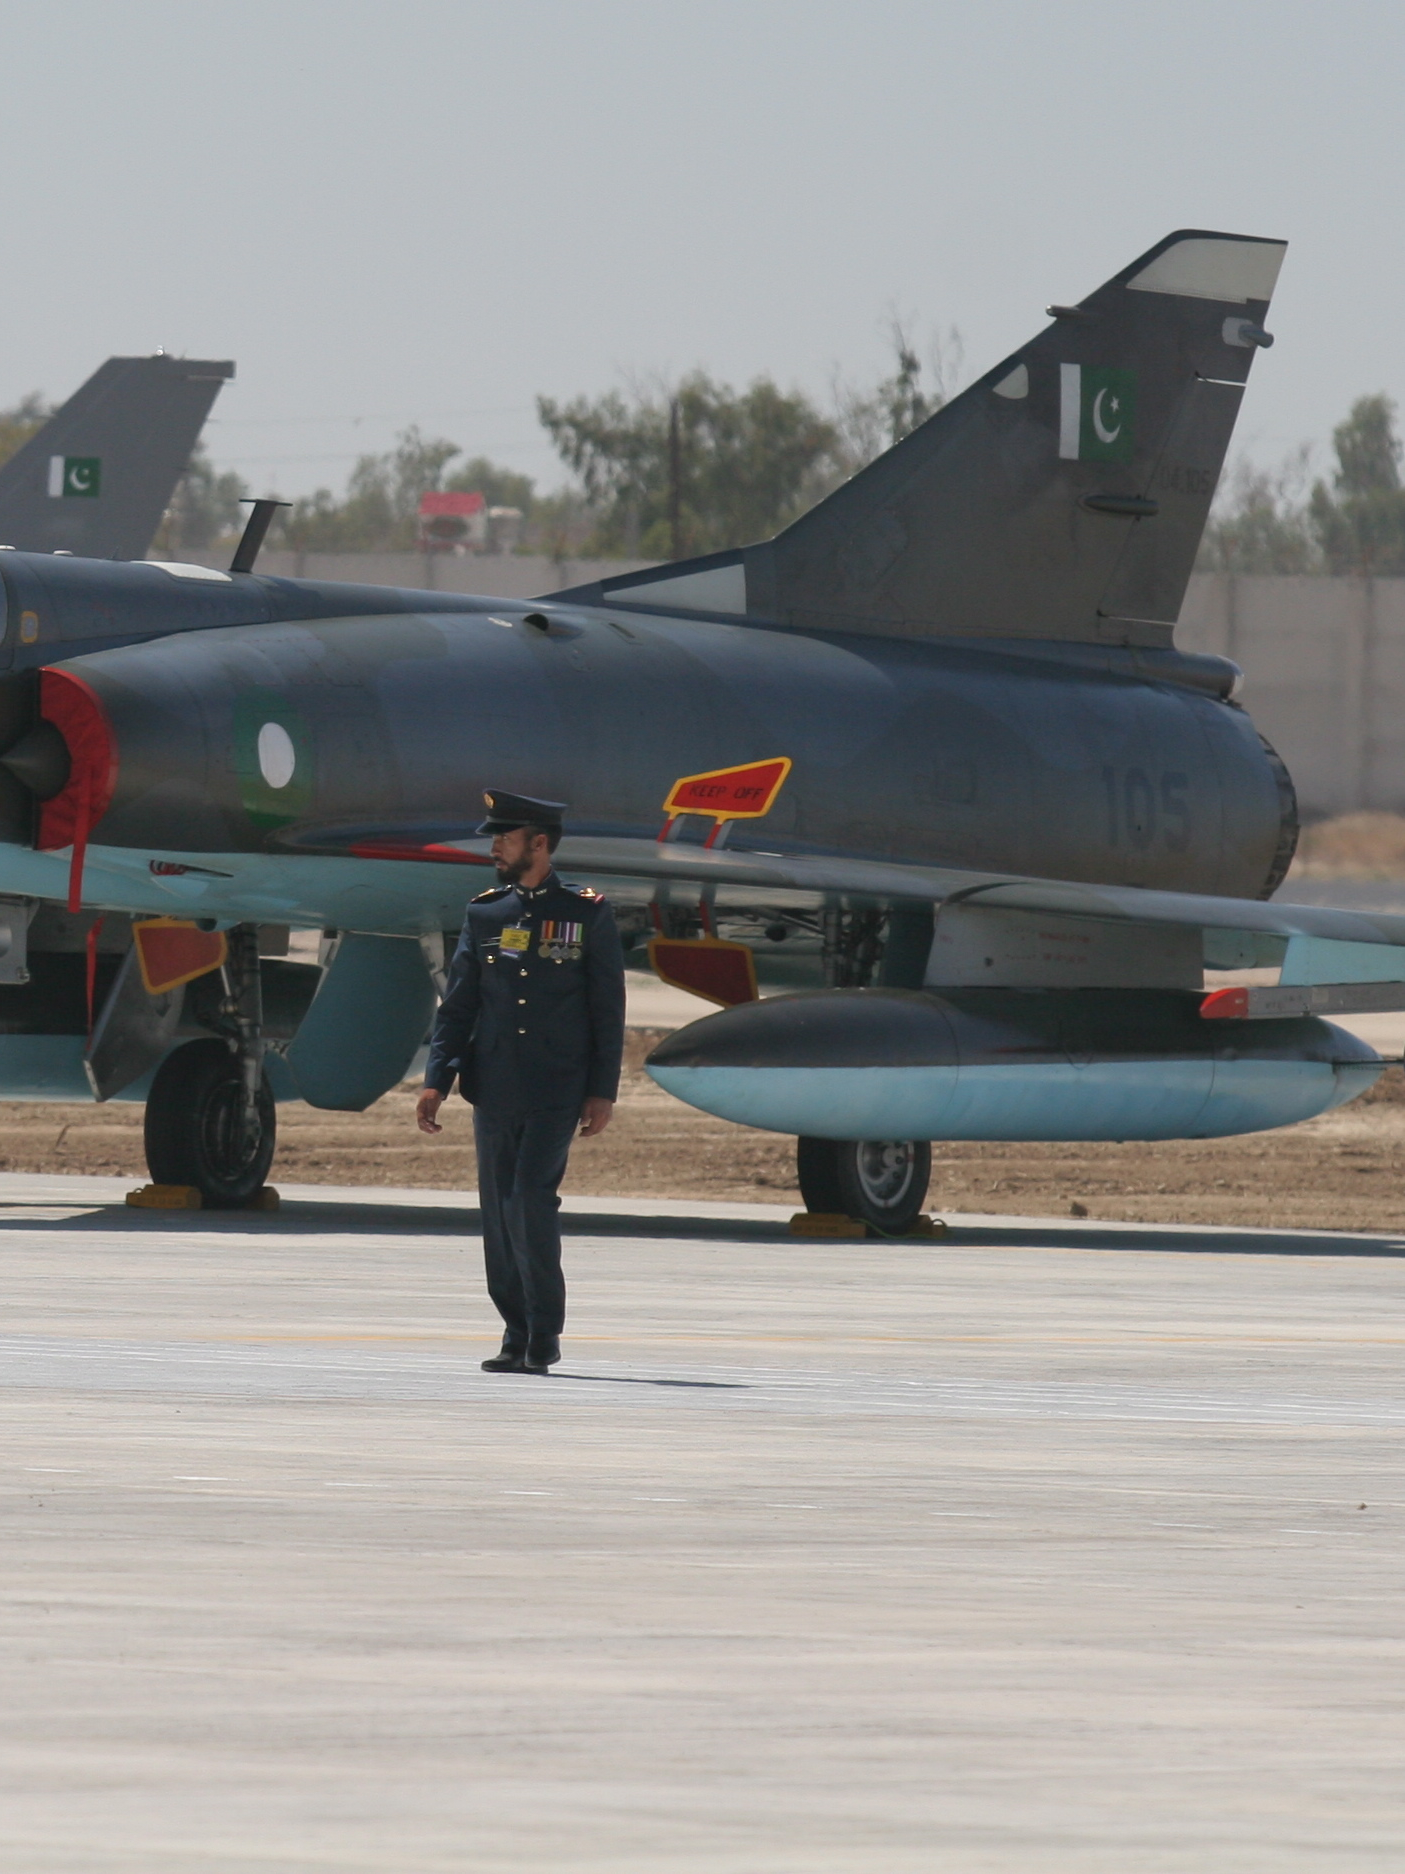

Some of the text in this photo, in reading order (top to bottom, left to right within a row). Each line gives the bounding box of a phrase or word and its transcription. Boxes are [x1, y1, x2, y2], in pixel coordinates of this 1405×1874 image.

[689, 784, 764, 800] KEEP OFF
[1101, 765, 1192, 853] 105
